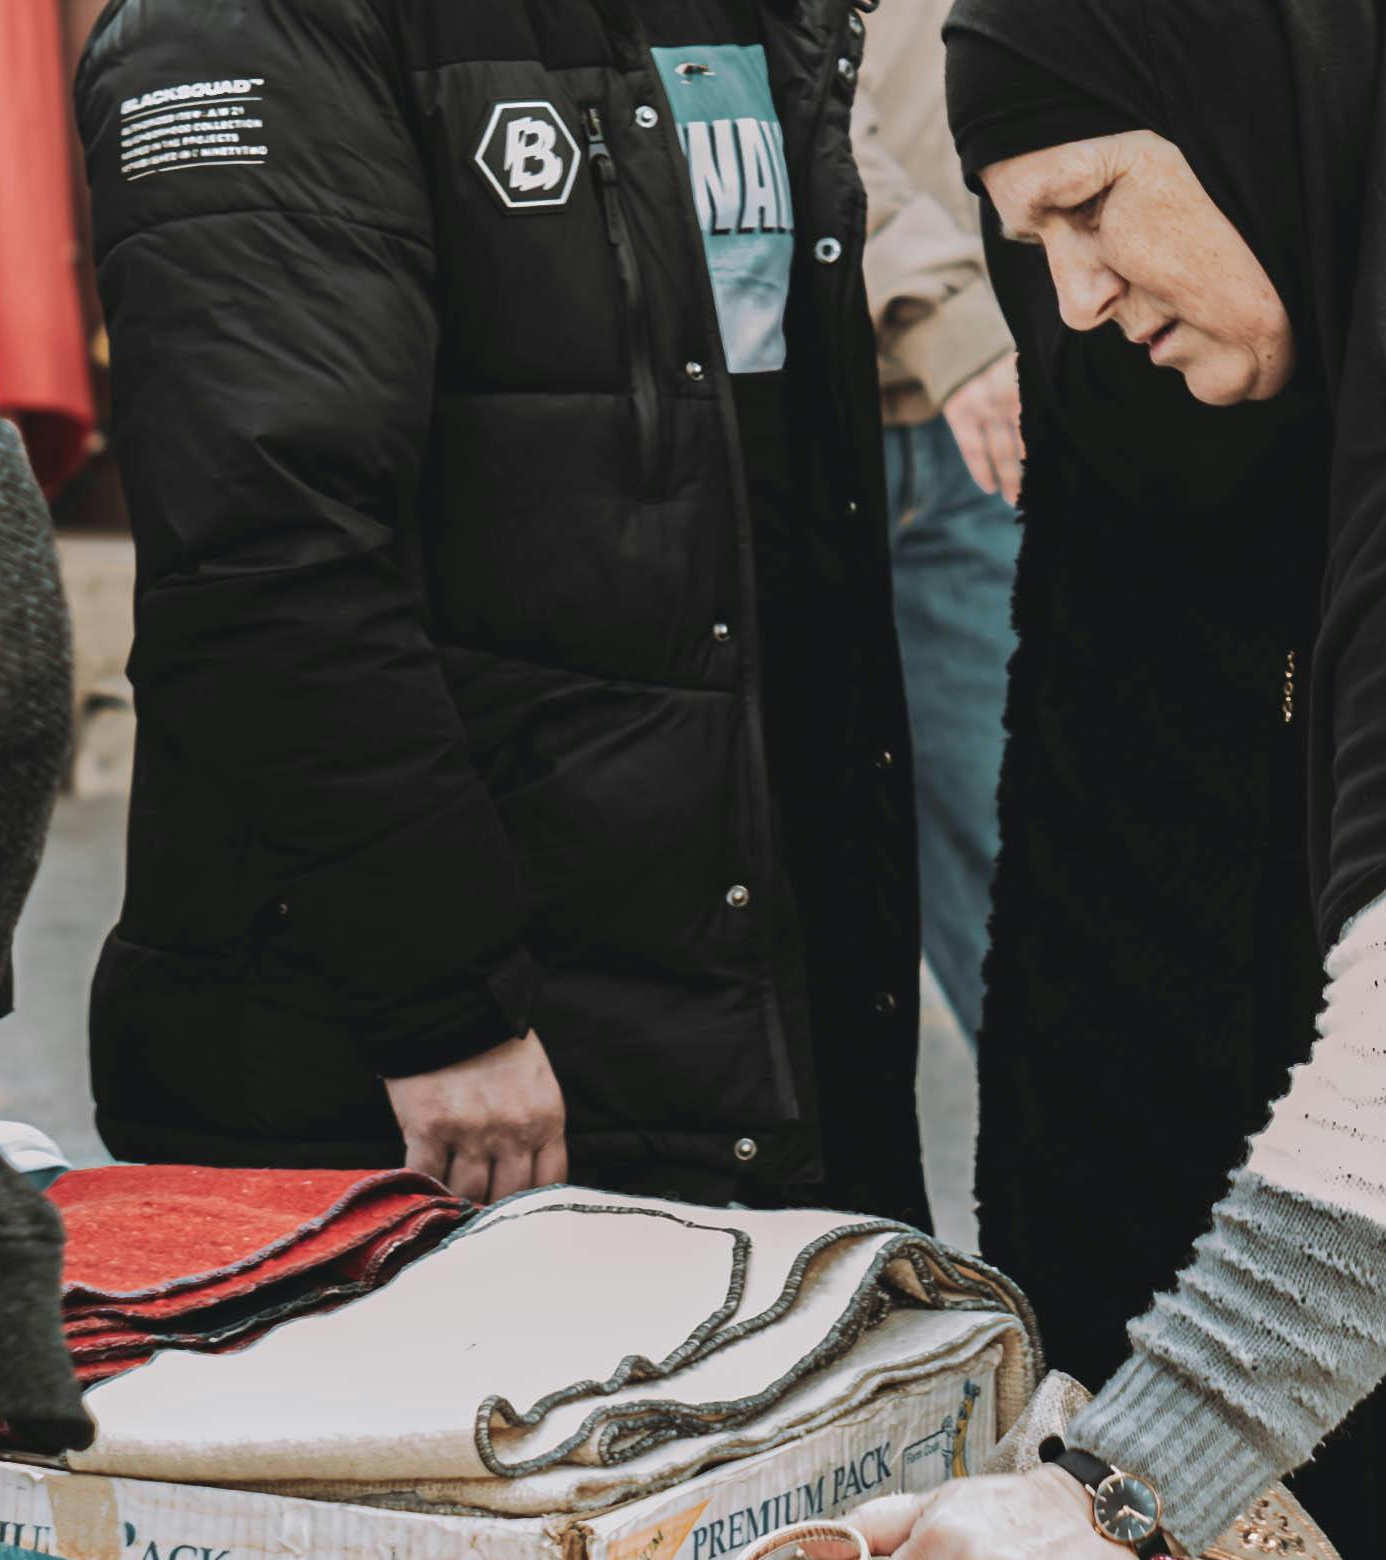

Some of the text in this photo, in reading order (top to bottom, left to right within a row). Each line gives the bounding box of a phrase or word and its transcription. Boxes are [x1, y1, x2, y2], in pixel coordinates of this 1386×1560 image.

[503, 116, 563, 191] B
[675, 118, 794, 232] NA
[832, 1442, 894, 1505] PACK
